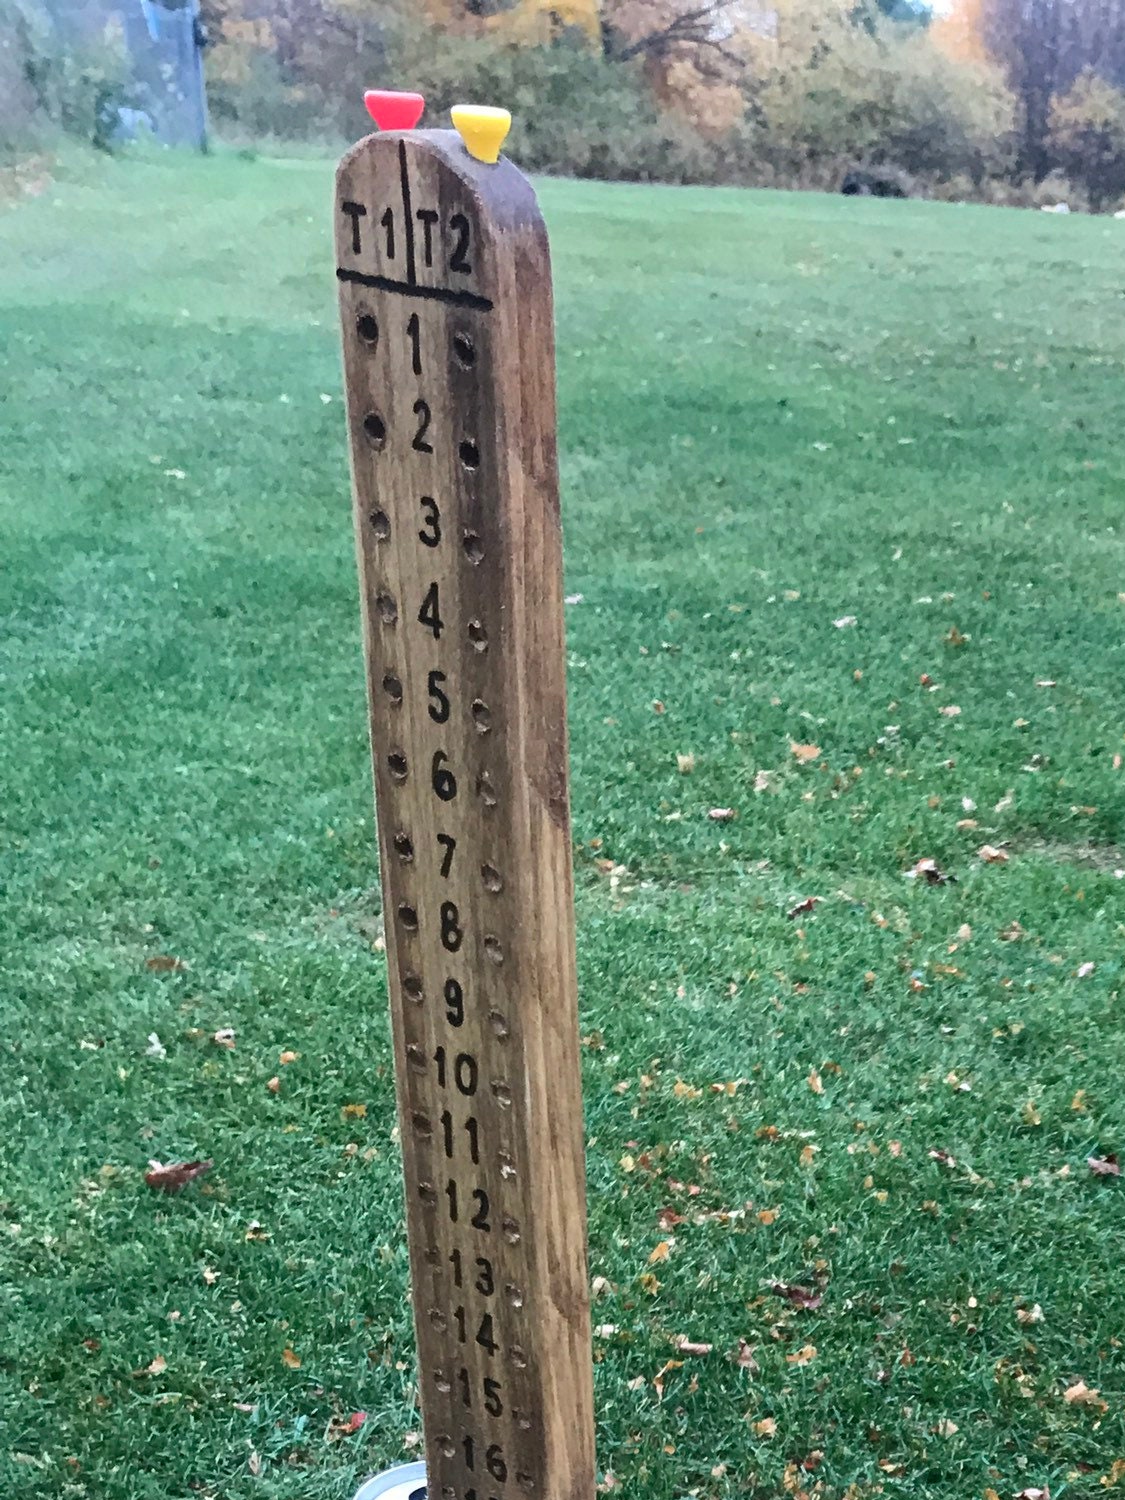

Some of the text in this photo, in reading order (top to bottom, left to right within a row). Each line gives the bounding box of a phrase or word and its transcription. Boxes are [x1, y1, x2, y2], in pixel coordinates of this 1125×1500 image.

[406, 313, 422, 376] 1
[412, 400, 433, 454] 2
[418, 496, 441, 548] 3
[417, 582, 444, 640] 4
[427, 670, 450, 724] 5
[431, 750, 457, 801] 6
[437, 833, 456, 879] 7
[440, 901, 463, 953] 8
[443, 978, 465, 1028] 9
[432, 1045, 478, 1096] 10
[440, 1110, 481, 1165] 11
[445, 1178, 491, 1233] 12
[449, 1248, 495, 1298] 13
[453, 1305, 500, 1357] 14
[458, 1367, 503, 1418] 15
[462, 1435, 507, 1484] 16
